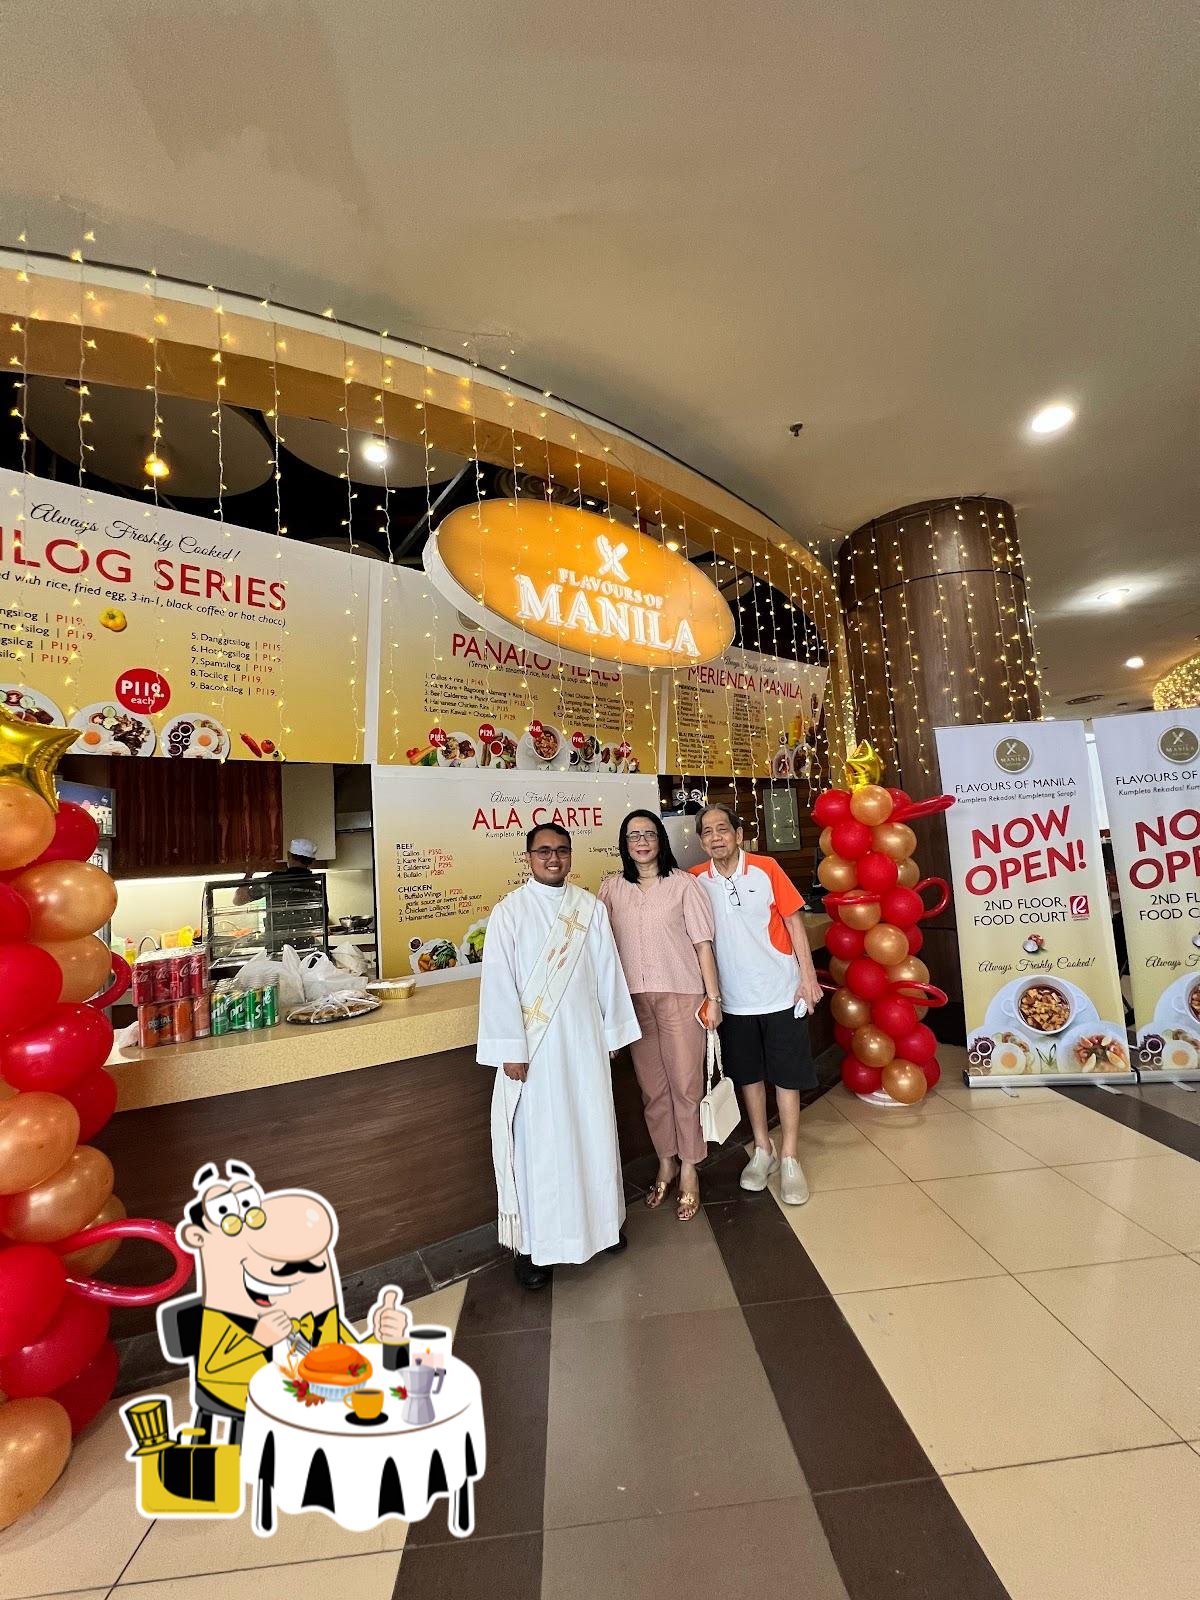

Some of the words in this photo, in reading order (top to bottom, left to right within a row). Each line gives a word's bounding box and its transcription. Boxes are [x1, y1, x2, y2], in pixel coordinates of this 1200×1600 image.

[31, 502, 99, 535] Always
[105, 520, 173, 552] Freshly
[178, 535, 241, 562] Cooked!
[154, 559, 287, 611] SERIES
[558, 567, 642, 604] FLAVOURS
[643, 592, 664, 609] OF
[46, 579, 71, 592] rice,
[74, 583, 102, 596] fried
[167, 599, 192, 611] black
[196, 604, 225, 616] coffee
[228, 611, 239, 619] or
[241, 611, 256, 621] hot
[514, 573, 701, 657] MANILA
[191, 632, 199, 641] 5.
[51, 641, 81, 652] P119.
[191, 644, 199, 653] 6.
[452, 633, 552, 671] PANALO
[41, 653, 72, 665] P119.
[191, 656, 199, 665] 7.
[200, 657, 241, 672] Spamsilog
[190, 668, 198, 677] 8.
[121, 680, 165, 698] P119.
[190, 681, 198, 689] 9.
[688, 665, 756, 692] MERIENDA
[759, 677, 803, 700] MANILA
[130, 696, 155, 705] each
[955, 781, 1012, 794] FLAVOURS
[1013, 780, 1030, 790] OF
[1032, 777, 1077, 789] MANILA
[1115, 771, 1179, 786] FLAVOURS
[1181, 770, 1198, 779] OF
[472, 806, 523, 830] ALA
[531, 806, 603, 828] CARTE
[972, 804, 1070, 859] NOW
[965, 839, 1088, 896] OPEN!
[397, 884, 433, 894] CHICKEN
[984, 899, 1013, 911] 2ND
[1017, 896, 1068, 910] FLOOR,
[1150, 893, 1181, 906] 2ND
[974, 914, 1015, 927] FOOD
[1019, 910, 1068, 924] COURT
[1139, 907, 1183, 921] FOOD
[978, 960, 1013, 975] Always
[1015, 957, 1054, 973] Freshly
[1056, 956, 1096, 970] Cooked!
[1145, 955, 1182, 971] Always
